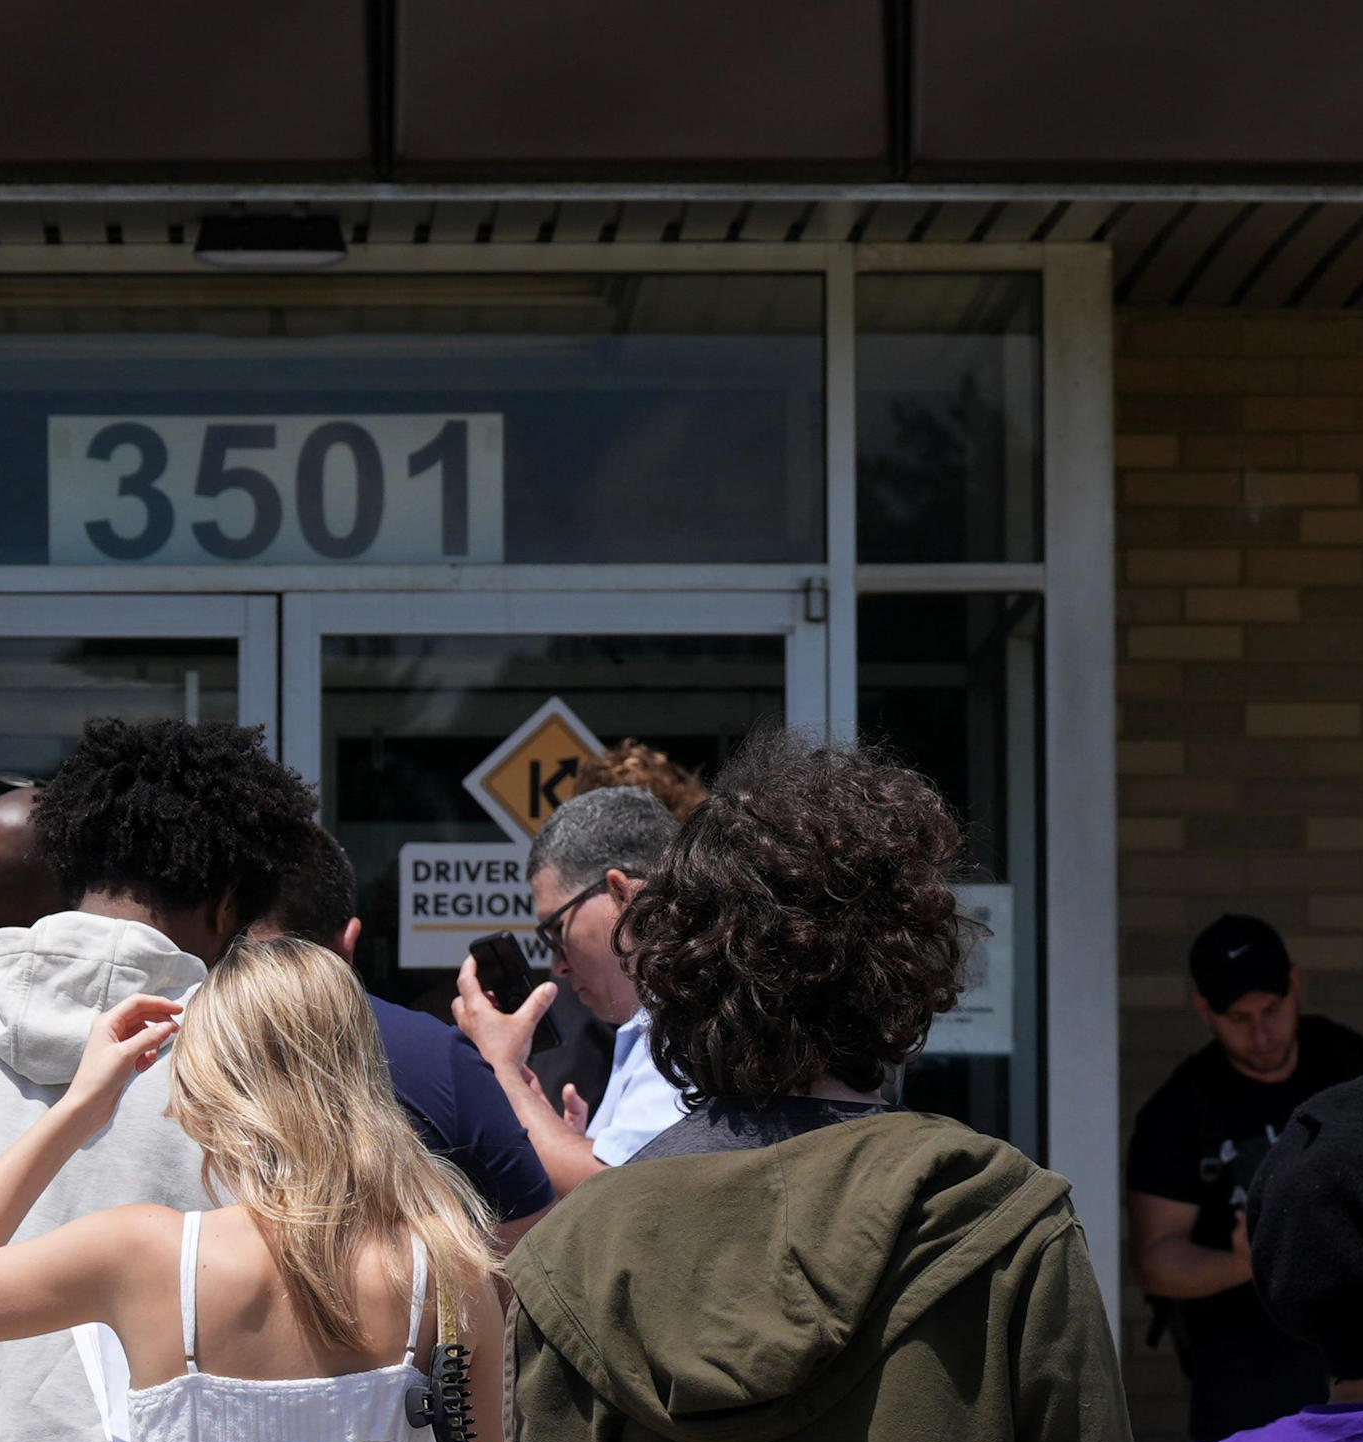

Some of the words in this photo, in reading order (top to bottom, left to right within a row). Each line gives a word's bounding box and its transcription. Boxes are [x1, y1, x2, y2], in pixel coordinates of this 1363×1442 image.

[84, 420, 469, 560] 3501
[413, 861, 519, 882] DRIVER
[413, 893, 532, 916] REGION
